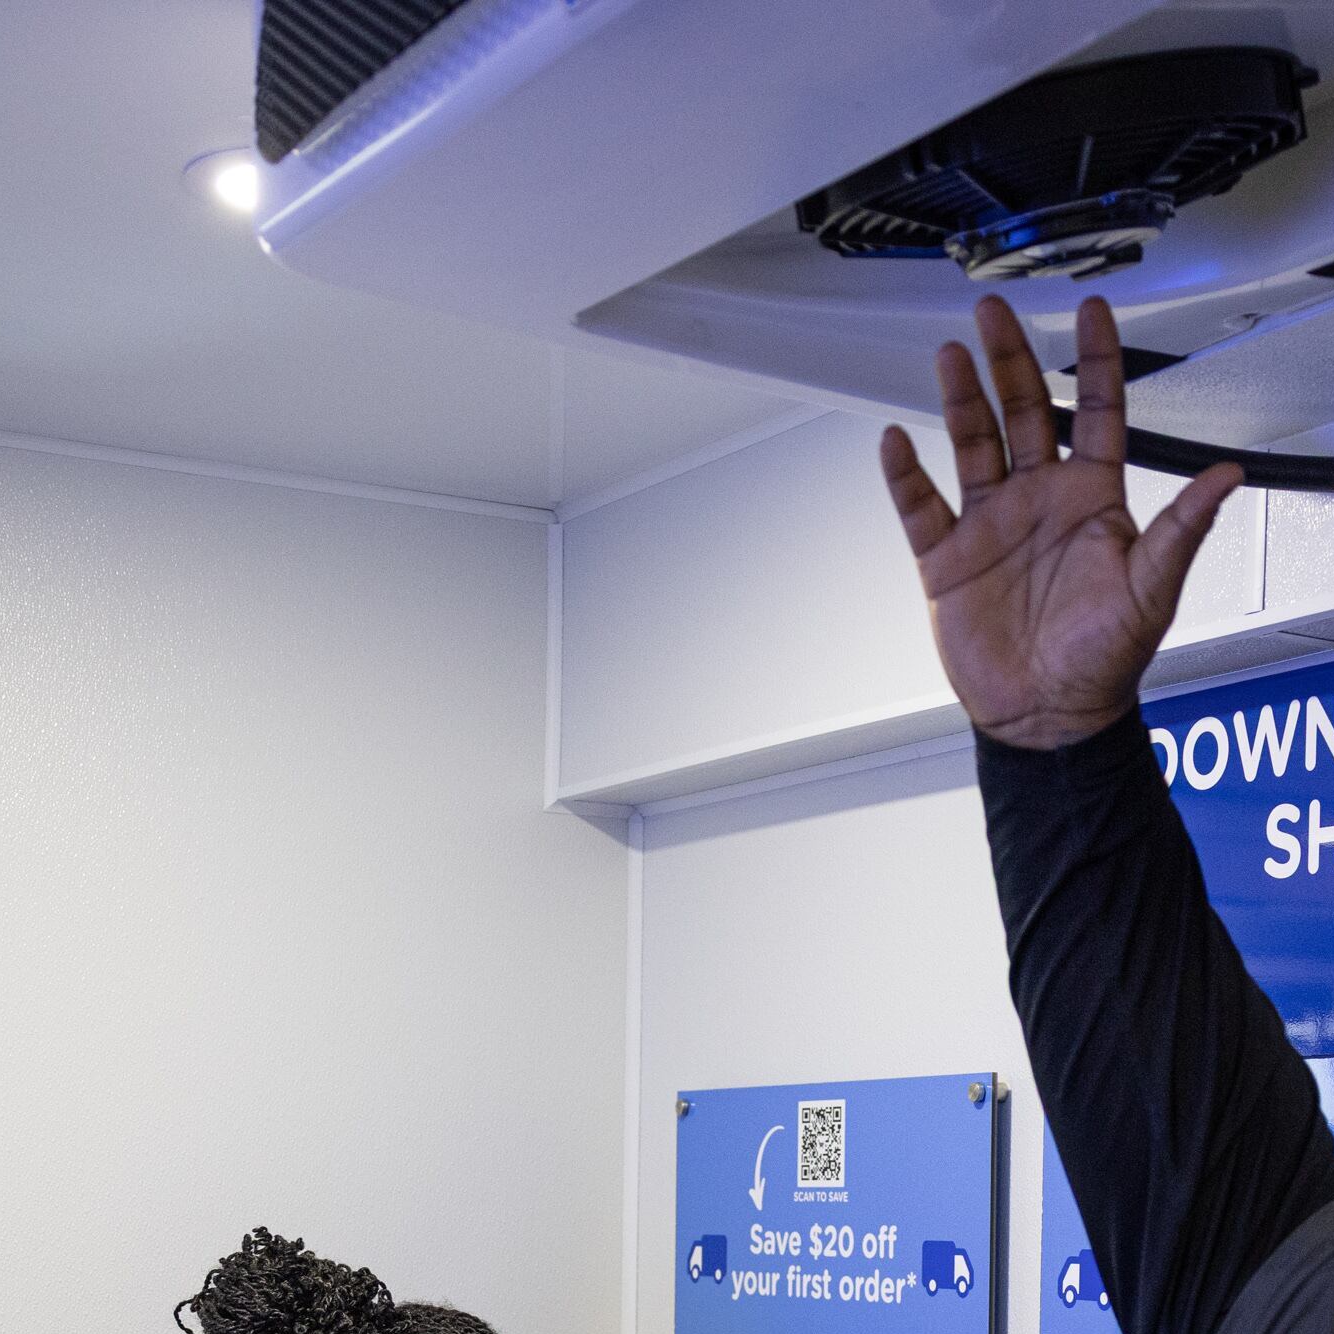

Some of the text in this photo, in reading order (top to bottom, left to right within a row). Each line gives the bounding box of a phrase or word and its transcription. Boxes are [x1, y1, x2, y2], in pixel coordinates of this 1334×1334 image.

[793, 1191, 849, 1203] SCAN TO SAVE
[750, 1223, 898, 1260] Save $20 off
[731, 1271, 780, 1300] your
[786, 1265, 832, 1300] first
